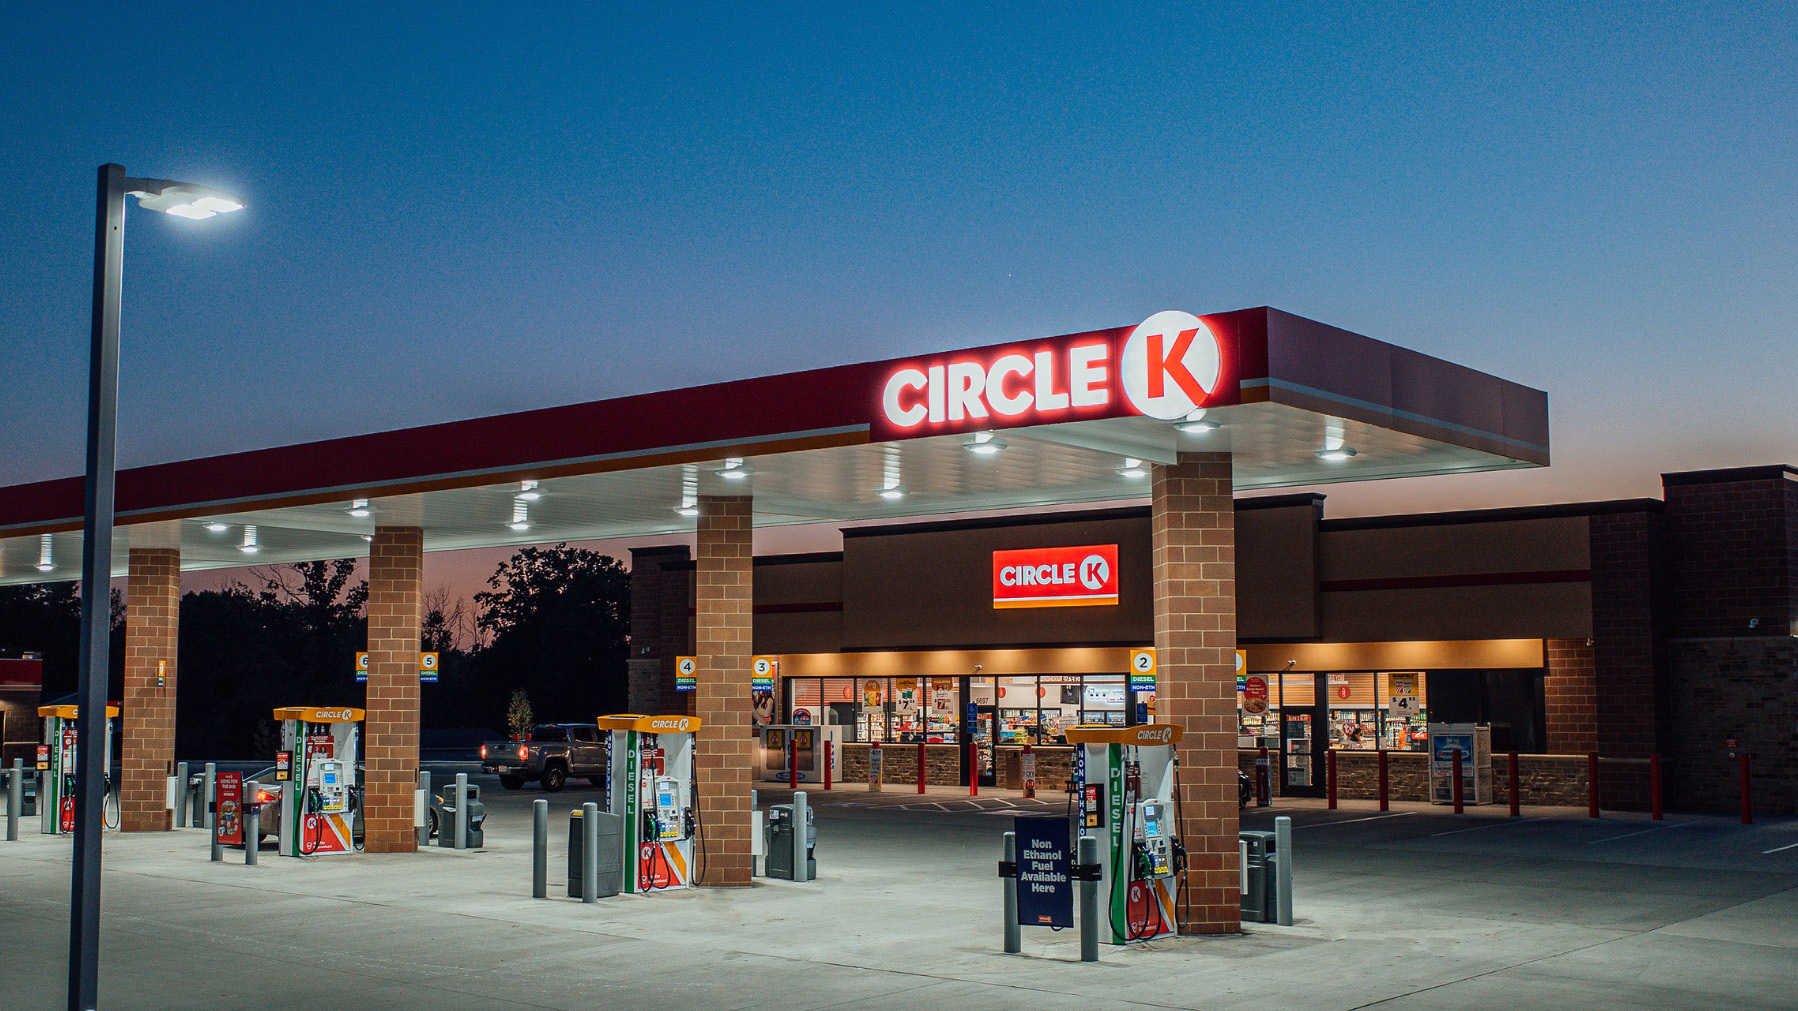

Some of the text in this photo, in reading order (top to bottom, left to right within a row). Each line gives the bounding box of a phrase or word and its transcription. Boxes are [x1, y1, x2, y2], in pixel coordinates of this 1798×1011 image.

[883, 325, 1214, 427] CIRCLE K
[1000, 560, 1108, 588] CIRCLE K
[683, 662, 691, 671] 4
[758, 663, 766, 672] 3
[1139, 657, 1148, 668] 2
[652, 719, 689, 730] CIRCLE K
[1137, 728, 1172, 741] CIRCLE K
[627, 750, 635, 814] DIESEL
[1078, 781, 1086, 835] ETHANO
[1110, 768, 1120, 847] DIESEL
[1031, 839, 1052, 849] Non
[1023, 849, 1062, 860] Ethanol
[1031, 861, 1054, 871] Fuel
[1021, 871, 1066, 882] Available
[1031, 883, 1056, 893] Here
